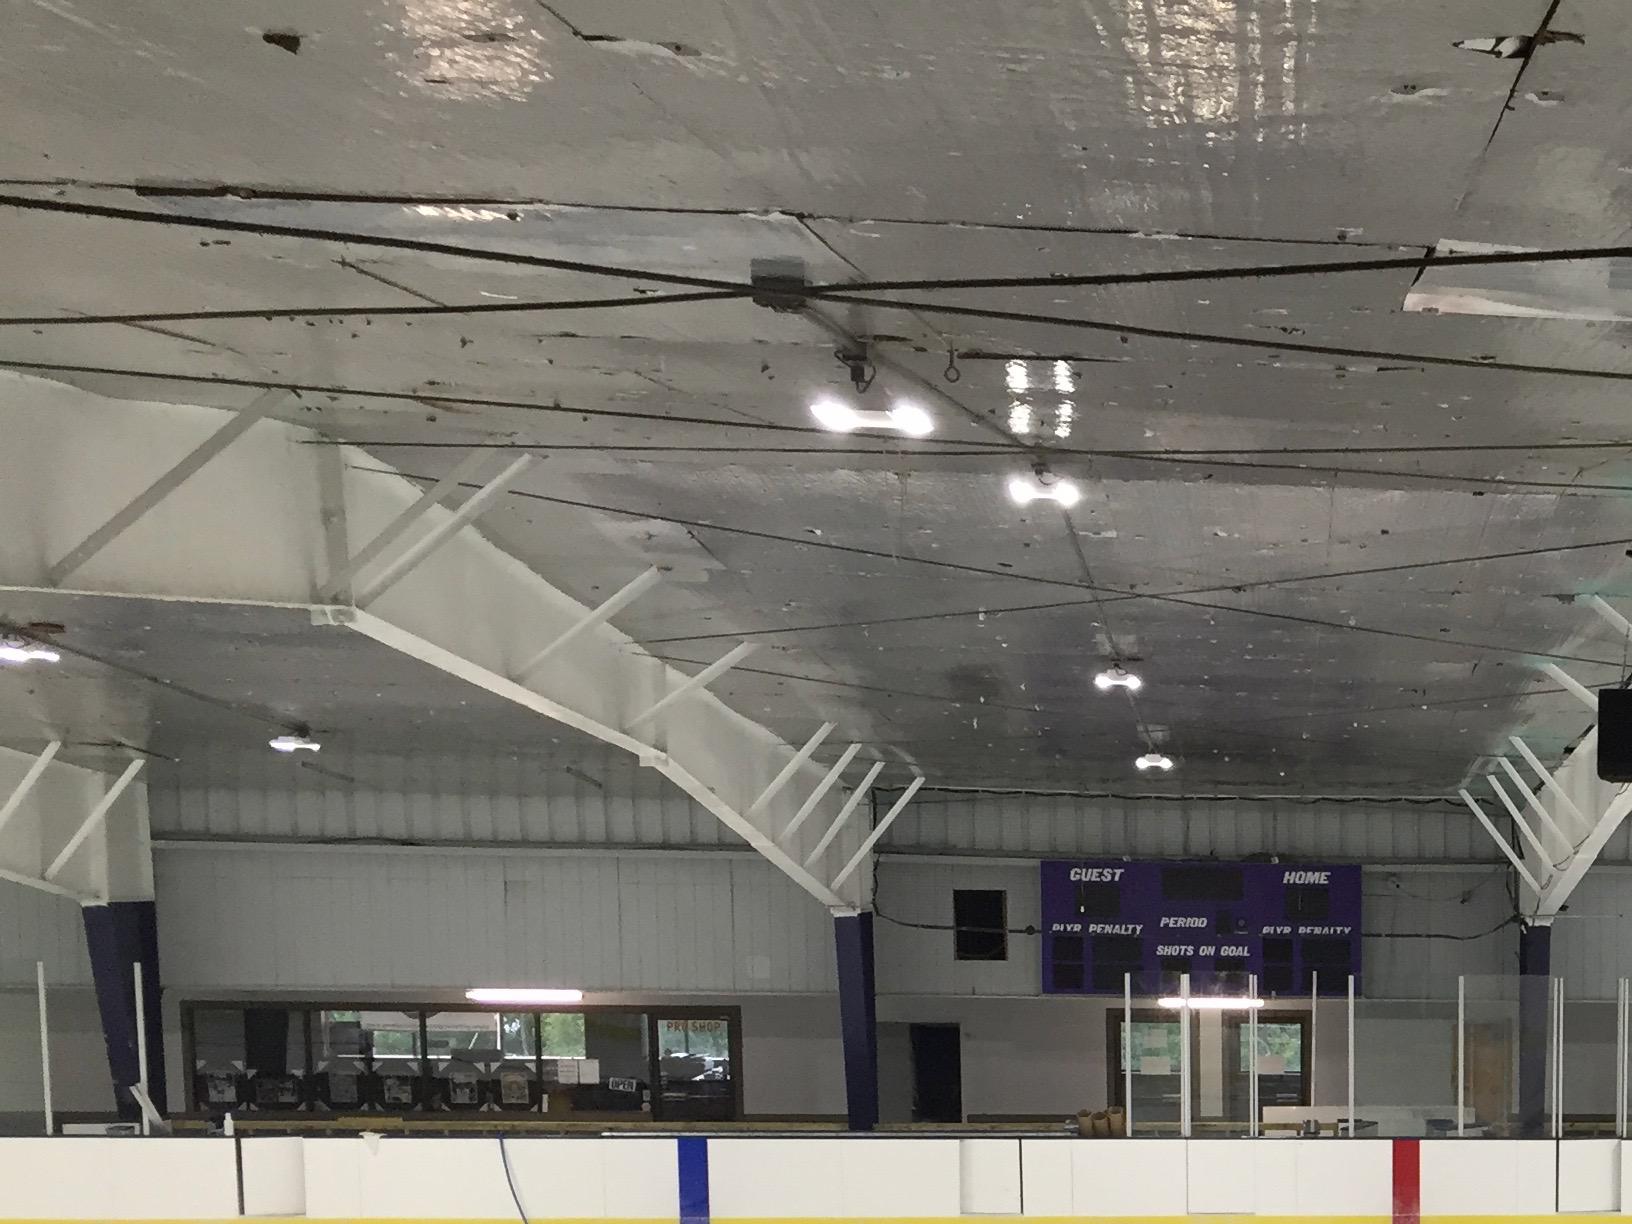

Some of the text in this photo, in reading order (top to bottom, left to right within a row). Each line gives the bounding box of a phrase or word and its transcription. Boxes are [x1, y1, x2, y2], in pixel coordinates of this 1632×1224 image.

[1070, 868, 1125, 882] GUEST
[1282, 871, 1331, 885] HOME
[1160, 917, 1208, 928] PERIOD
[1088, 923, 1143, 936] PENALTY
[1298, 926, 1352, 935] PENALTY
[1156, 945, 1251, 957] SHOTS ON GOAL
[666, 1021, 721, 1033] PRO SHOP
[611, 1079, 636, 1091] OPEN
